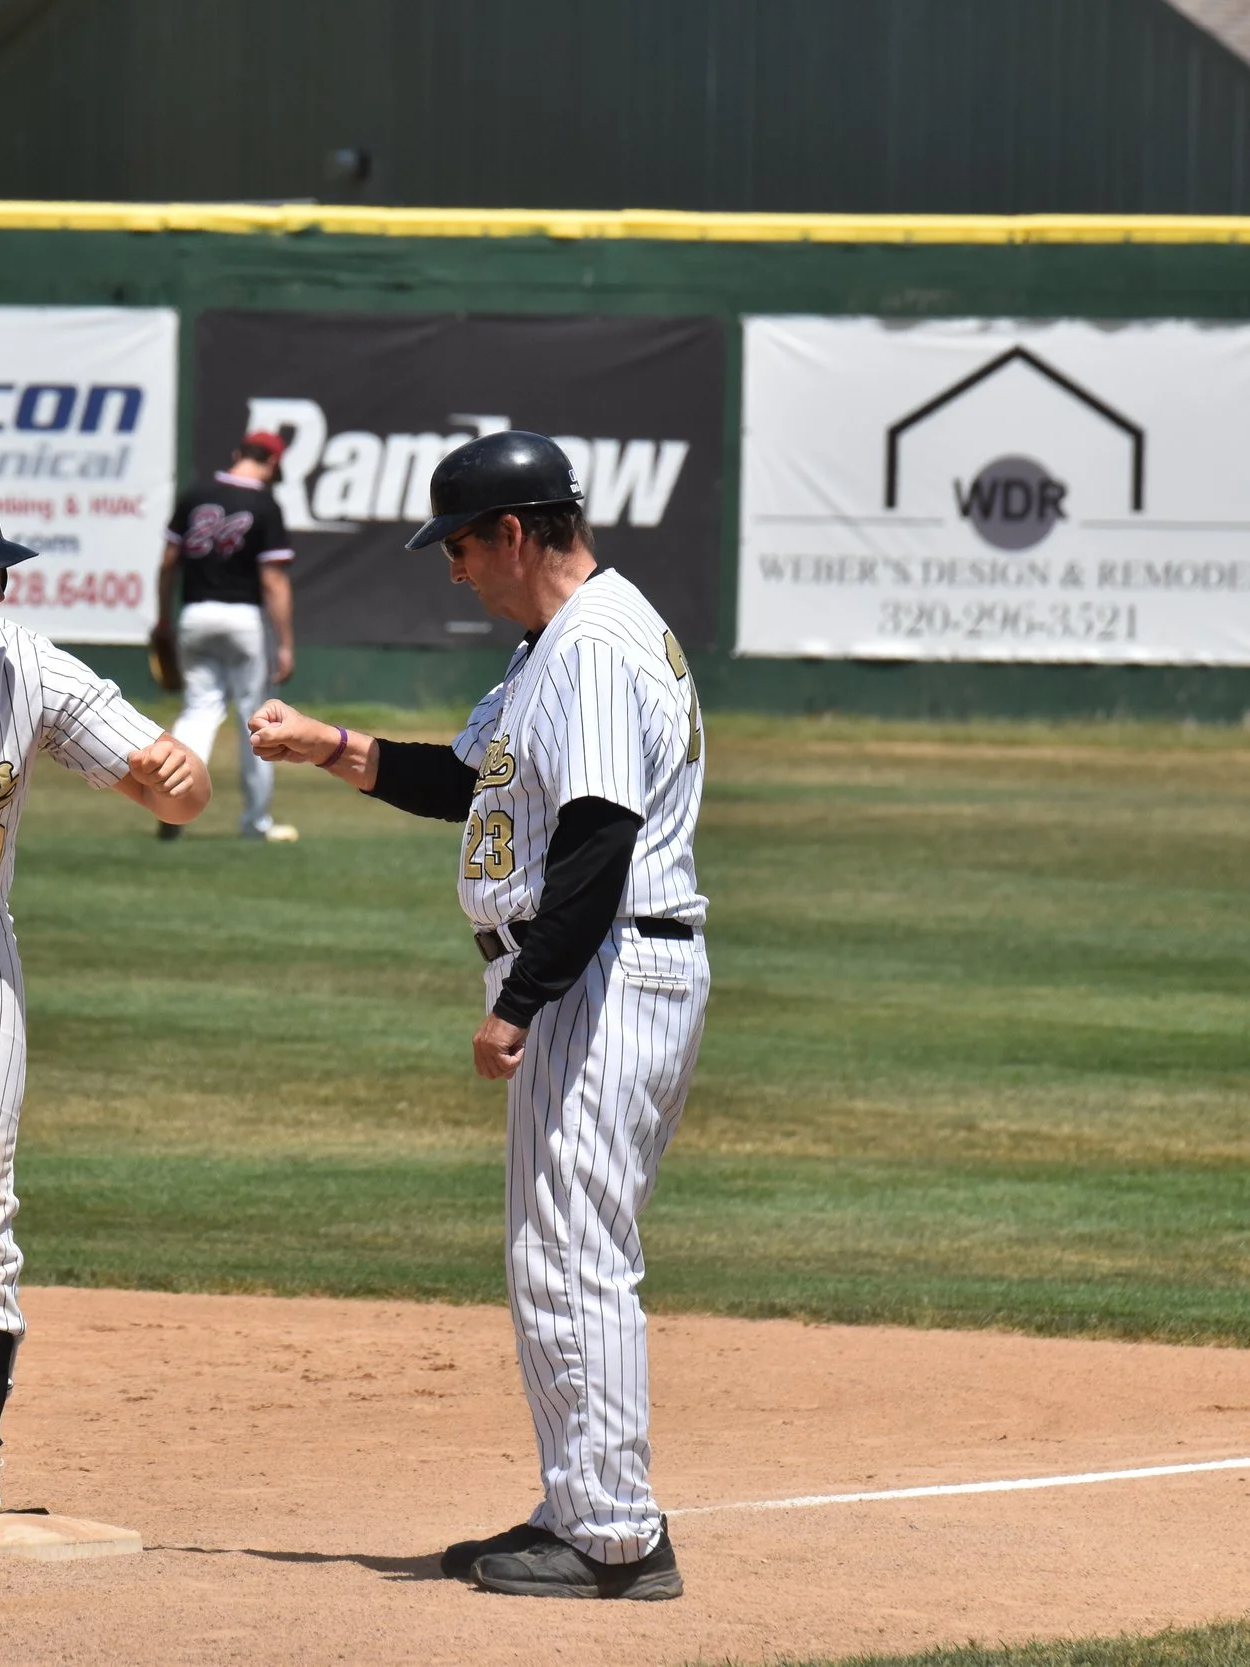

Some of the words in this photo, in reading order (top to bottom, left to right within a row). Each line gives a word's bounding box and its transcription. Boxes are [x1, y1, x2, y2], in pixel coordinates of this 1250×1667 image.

[953, 476, 1070, 523] WDR
[758, 553, 912, 586] WEBER'S
[921, 556, 1051, 590] DESIGN
[1059, 559, 1086, 590] &
[877, 597, 1138, 642] 320-296-3521
[463, 810, 516, 880] 23
